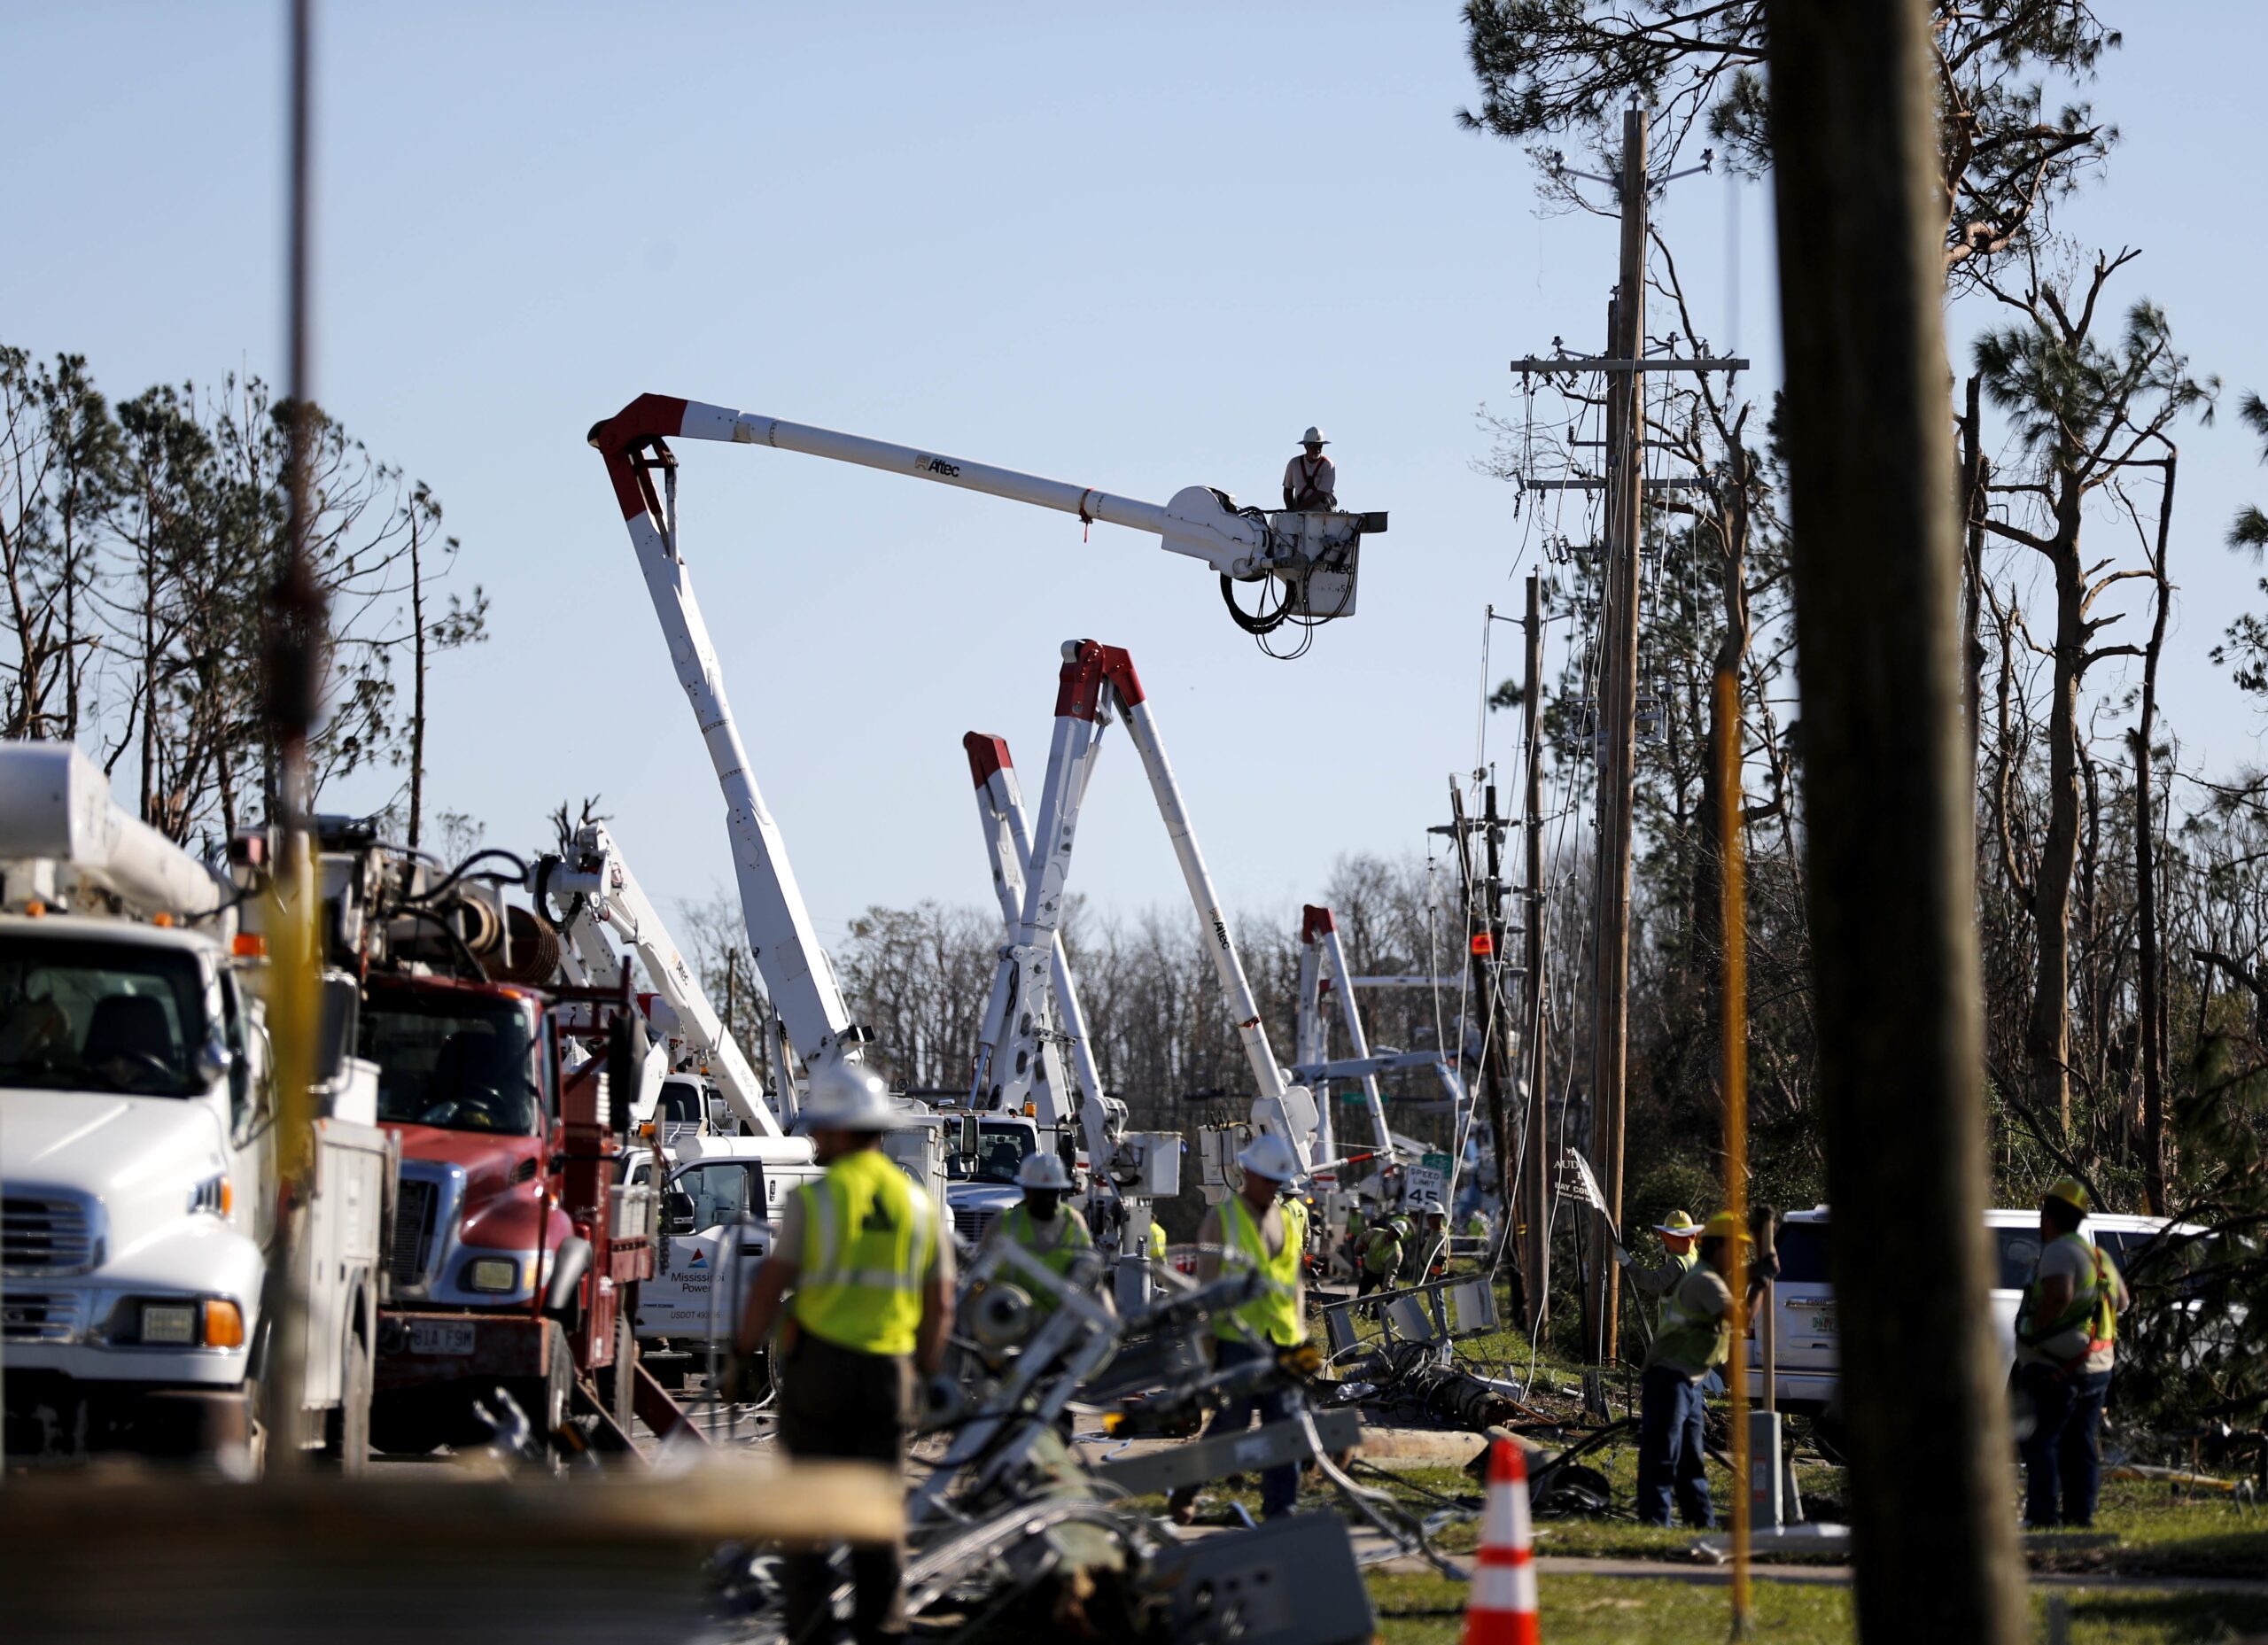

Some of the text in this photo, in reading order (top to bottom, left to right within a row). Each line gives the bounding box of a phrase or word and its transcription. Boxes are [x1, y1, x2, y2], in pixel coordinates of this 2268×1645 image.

[928, 458, 960, 477] Altec
[1214, 921, 1230, 950] Altec
[676, 960, 688, 986] Altec
[1410, 1168, 1440, 1180] SPEED
[1413, 1179, 1435, 1188] LIMIT
[1409, 1189, 1438, 1205] 45
